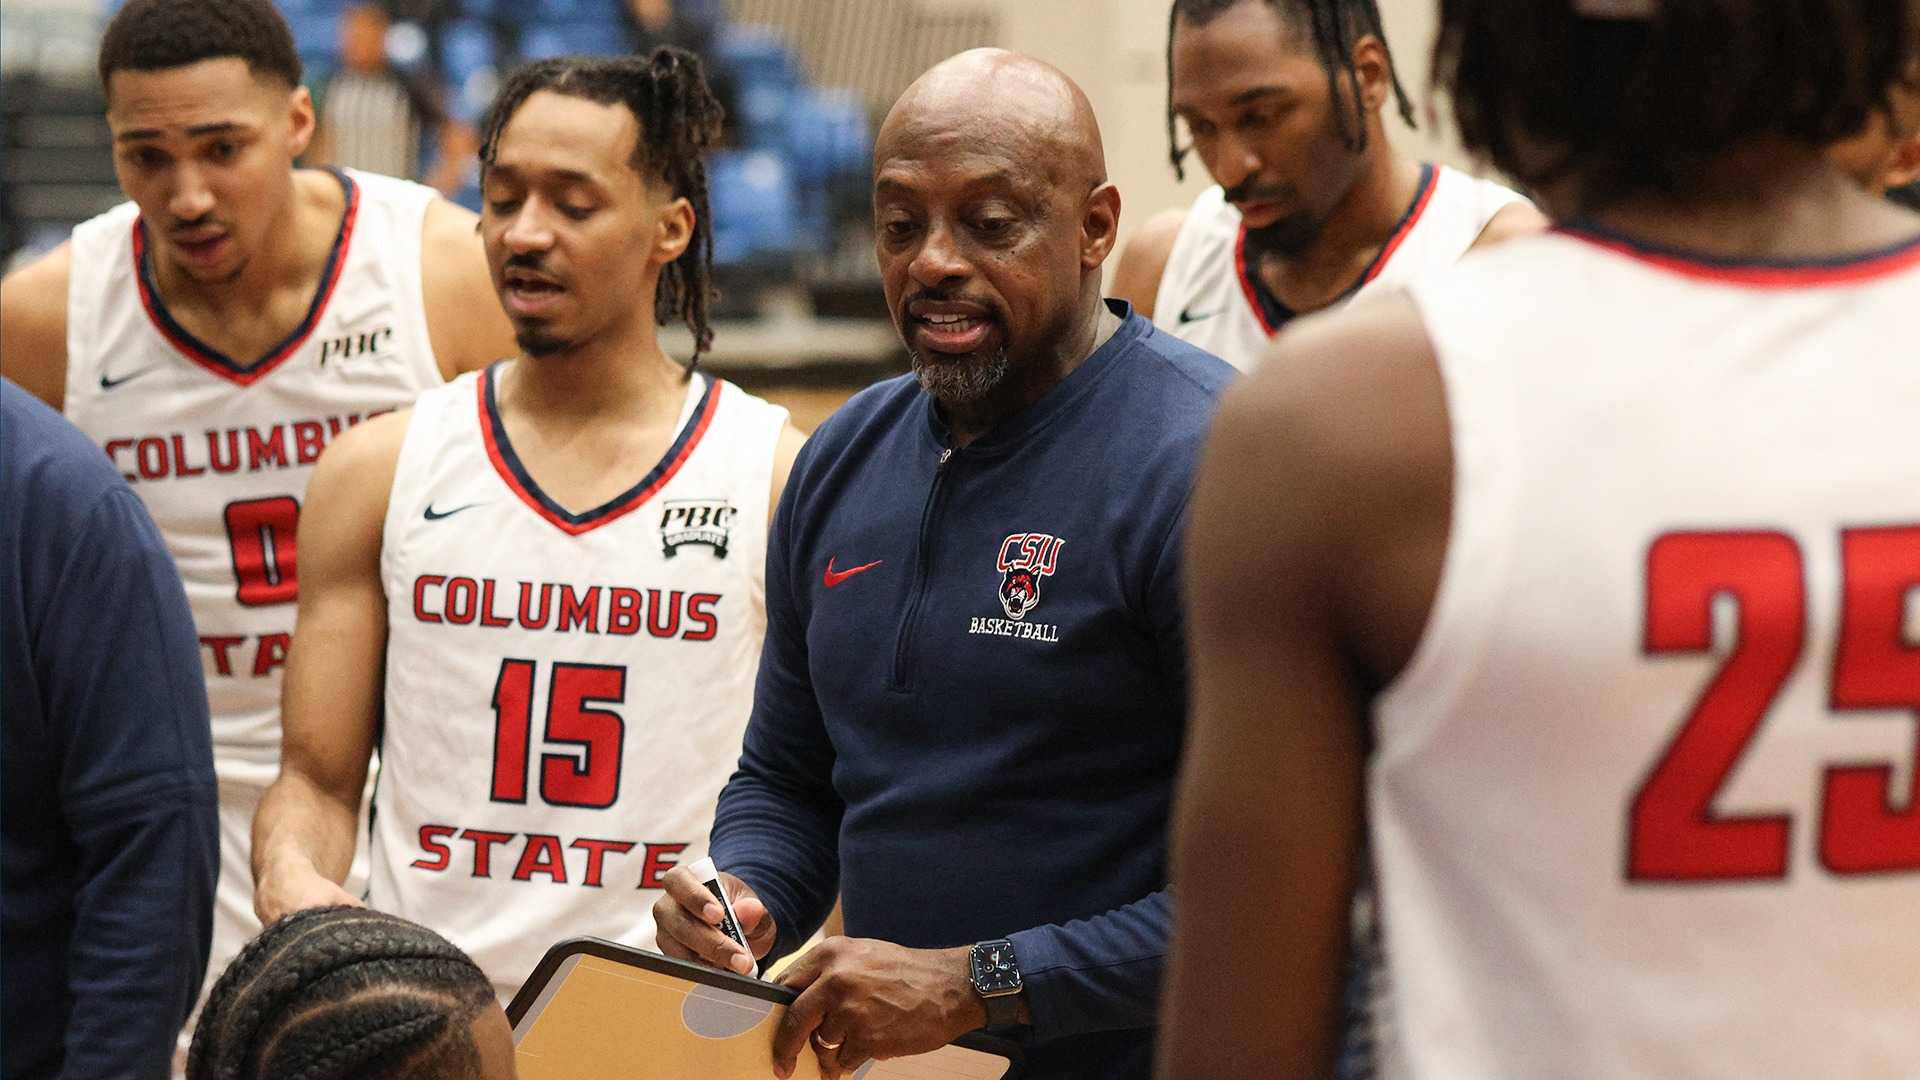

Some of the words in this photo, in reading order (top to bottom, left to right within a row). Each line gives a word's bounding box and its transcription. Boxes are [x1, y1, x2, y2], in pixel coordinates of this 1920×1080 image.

[105, 406, 398, 484] COLUMB
[224, 495, 299, 607] 0
[660, 506, 738, 529] PBC
[664, 530, 727, 547] GRADUATE
[996, 533, 1066, 577] CSU
[413, 574, 724, 642] COLUMBUS
[968, 617, 1060, 643] BASKETBALL
[490, 658, 628, 810] 15
[1623, 523, 1920, 887] 25
[410, 824, 693, 890] STATE
